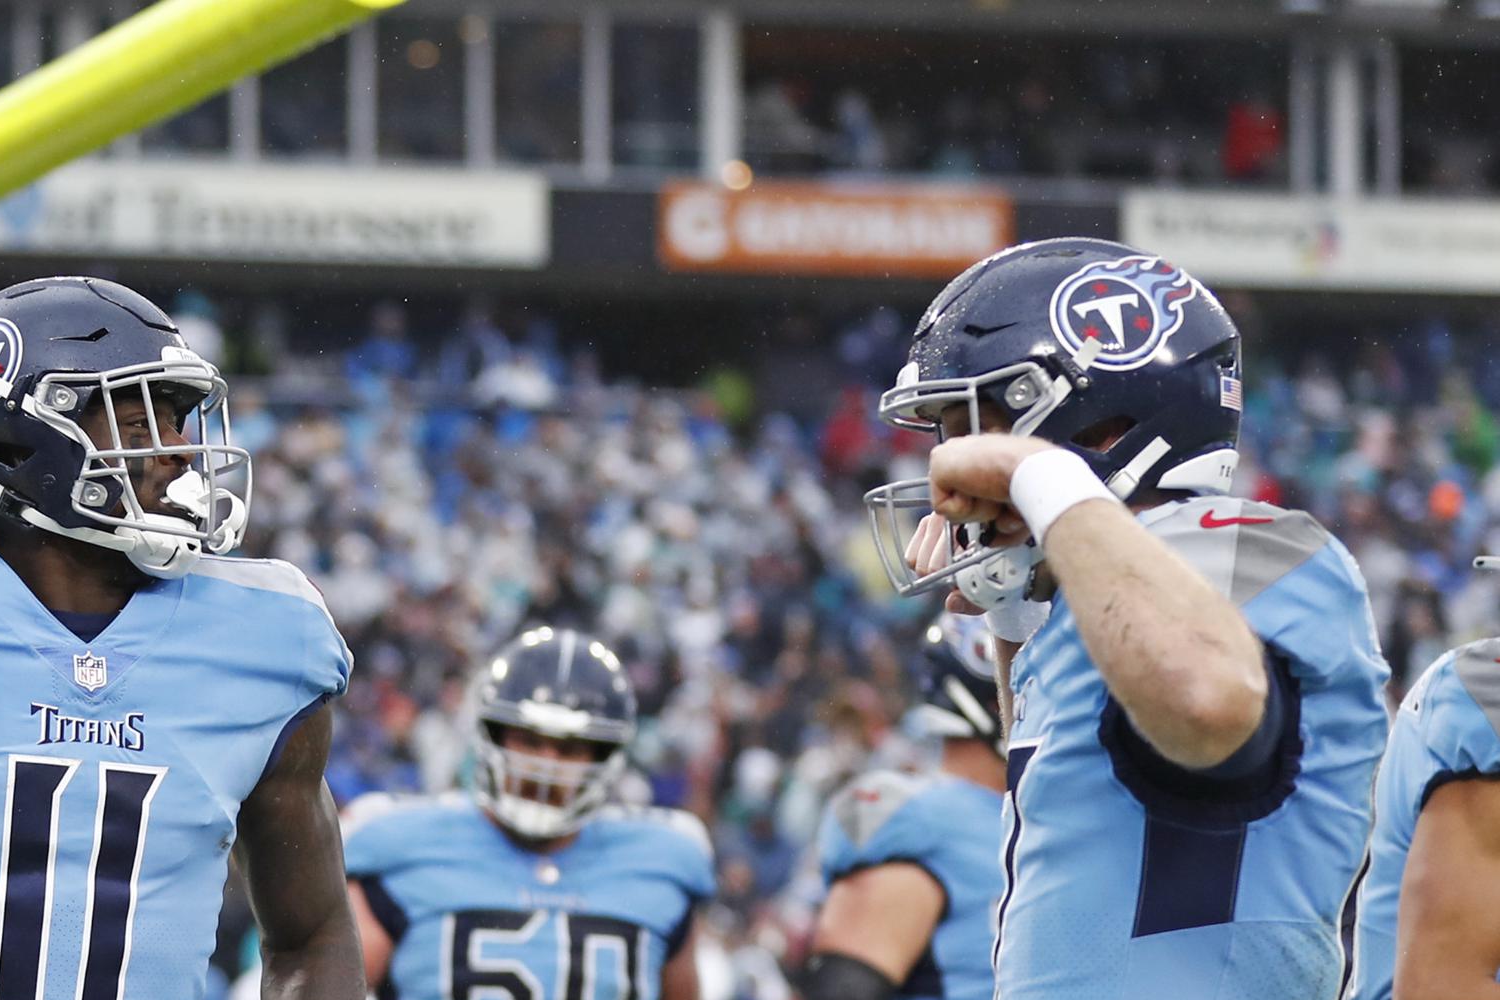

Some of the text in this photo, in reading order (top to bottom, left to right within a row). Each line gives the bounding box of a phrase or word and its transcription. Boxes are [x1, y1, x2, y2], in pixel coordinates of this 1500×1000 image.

[1071, 293, 1139, 348] T
[80, 668, 103, 682] NFL
[30, 702, 145, 751] TITANS
